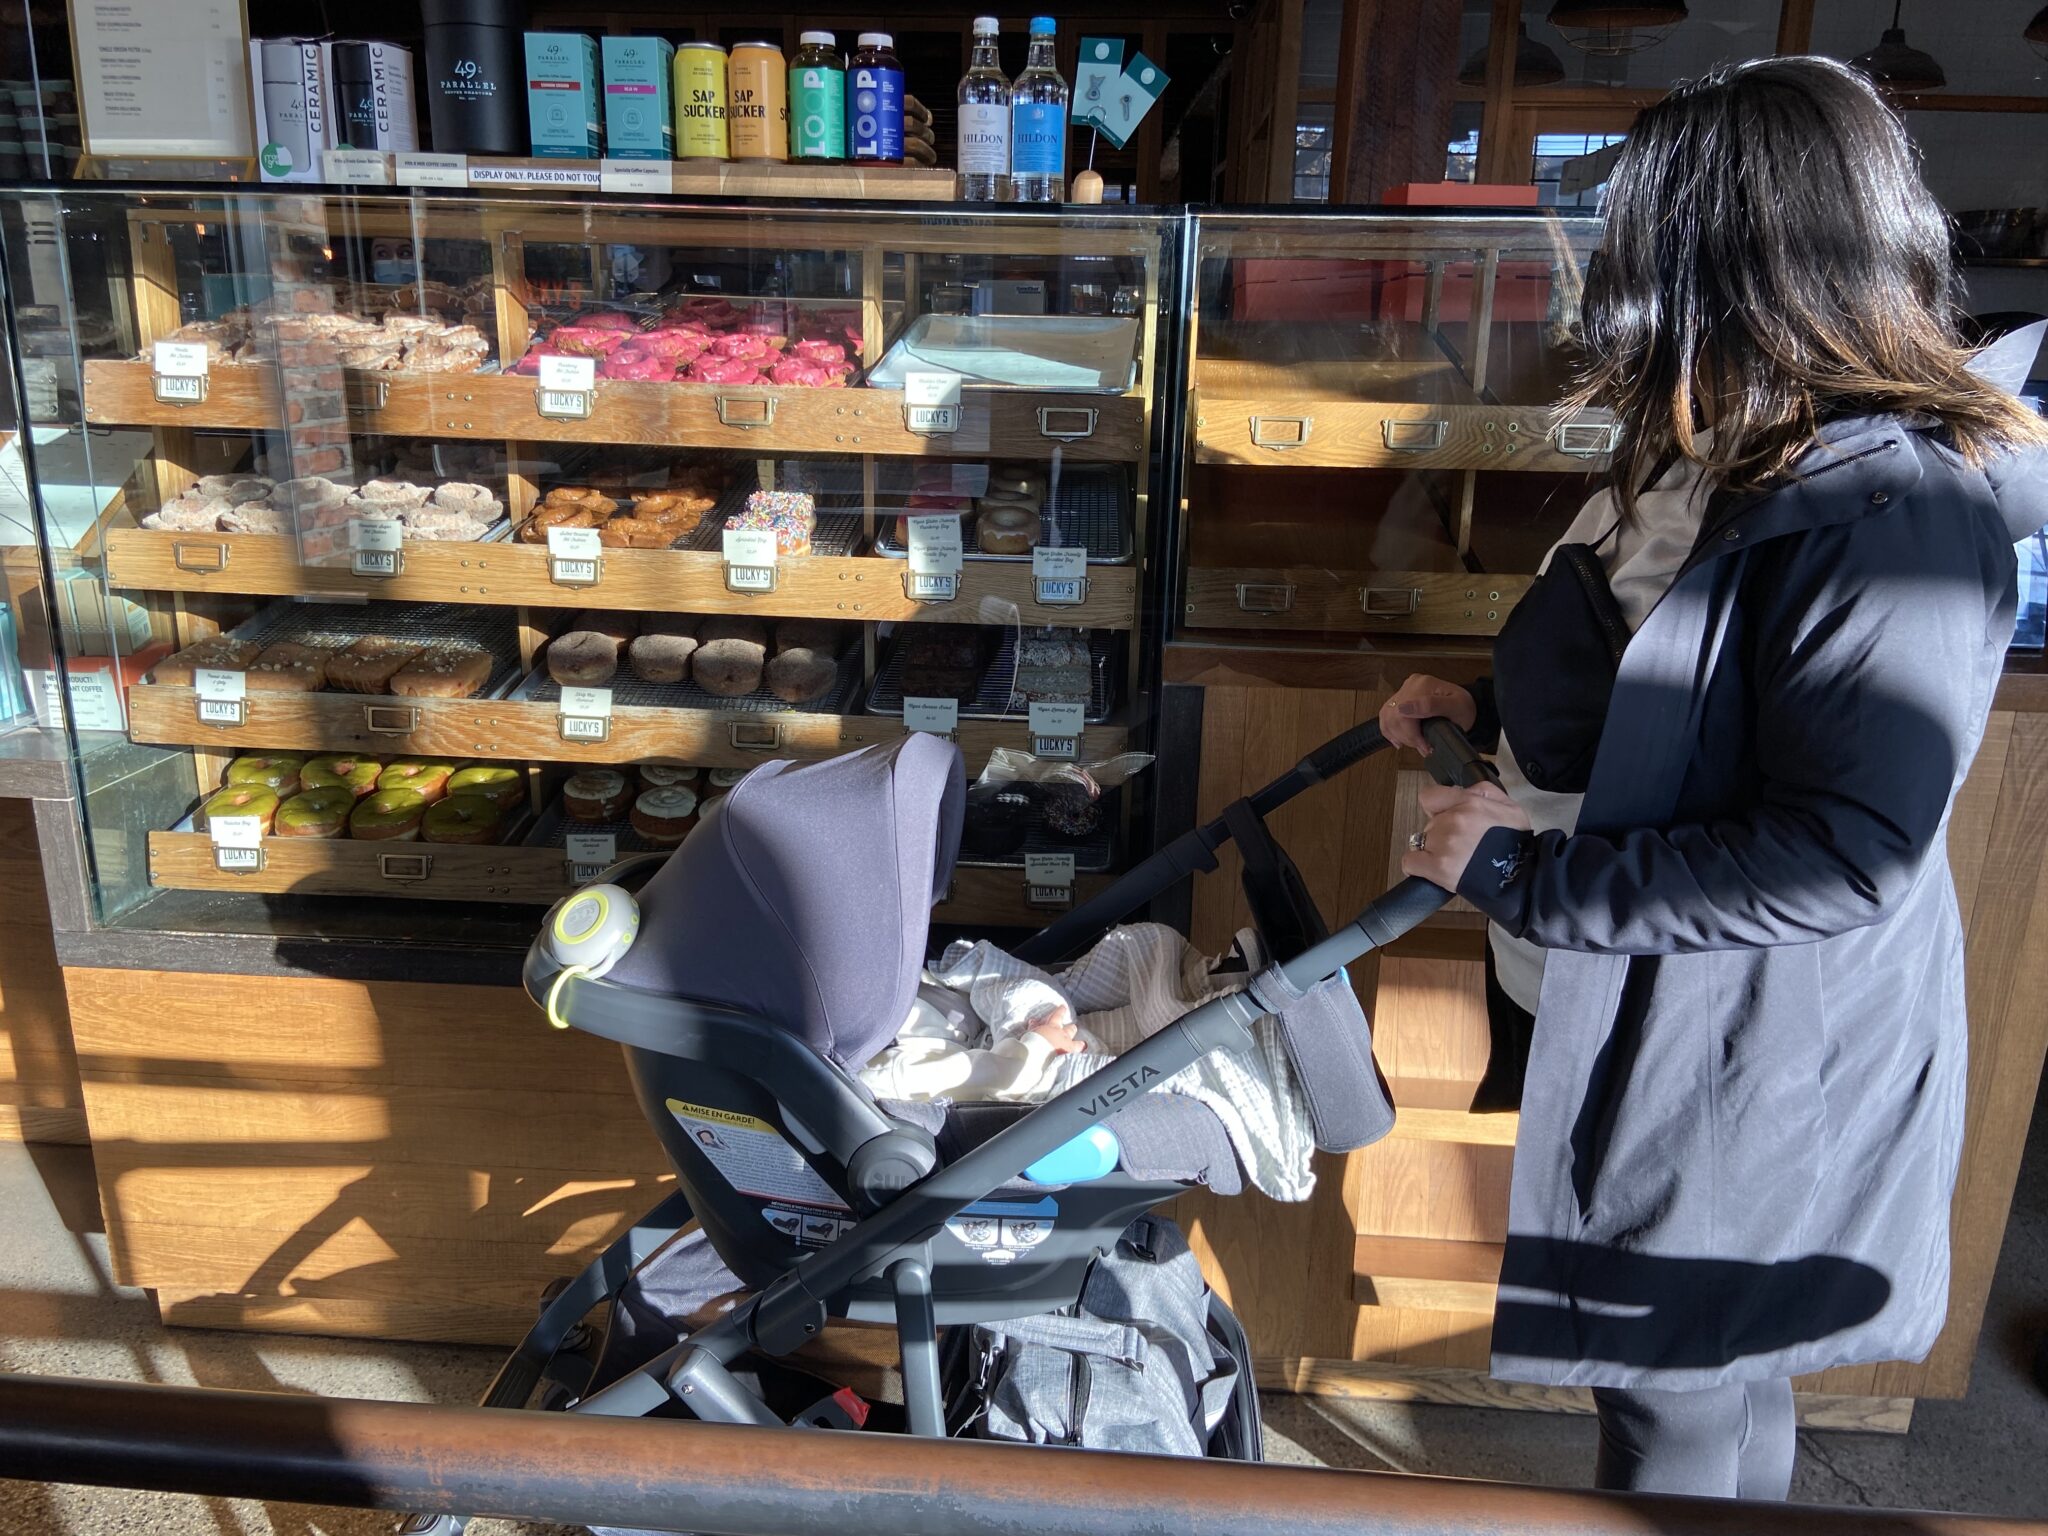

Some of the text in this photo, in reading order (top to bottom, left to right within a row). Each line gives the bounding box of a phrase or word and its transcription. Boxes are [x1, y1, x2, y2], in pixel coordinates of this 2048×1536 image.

[305, 48, 321, 133] CERAMIC
[372, 47, 389, 132] CERAMIC
[440, 81, 496, 90] PARALLEL
[692, 90, 715, 103] SAP
[734, 90, 753, 103] SAP
[684, 104, 725, 119] SUCKER
[963, 133, 1003, 144] HILDON
[1017, 133, 1058, 144] HILDON
[474, 170, 503, 179] DISPLAY
[504, 171, 526, 180] ONLY.
[527, 172, 553, 180] PLEASE
[566, 173, 581, 181] NOT
[583, 174, 600, 182] TOUC
[166, 377, 196, 392] LUCKY'S
[550, 393, 581, 407] LUCKY'S
[916, 410, 948, 423] LUCKY'S
[361, 553, 391, 566] LUCKY'S
[561, 561, 591, 573] LUCKY'S
[736, 568, 768, 580] LUCKY'S
[920, 576, 951, 588] LUCKY'S
[1042, 582, 1074, 594] LUCKY'S
[82, 685, 104, 693] COFFEE
[206, 702, 235, 715] LUCKY'S
[569, 720, 599, 733] LUCKY'S
[1040, 738, 1072, 751] LUCKY'S
[224, 850, 255, 860] LUCKY'S
[1078, 1065, 1160, 1116] VISTA
[690, 1106, 755, 1125] MISE EN GARDE!
